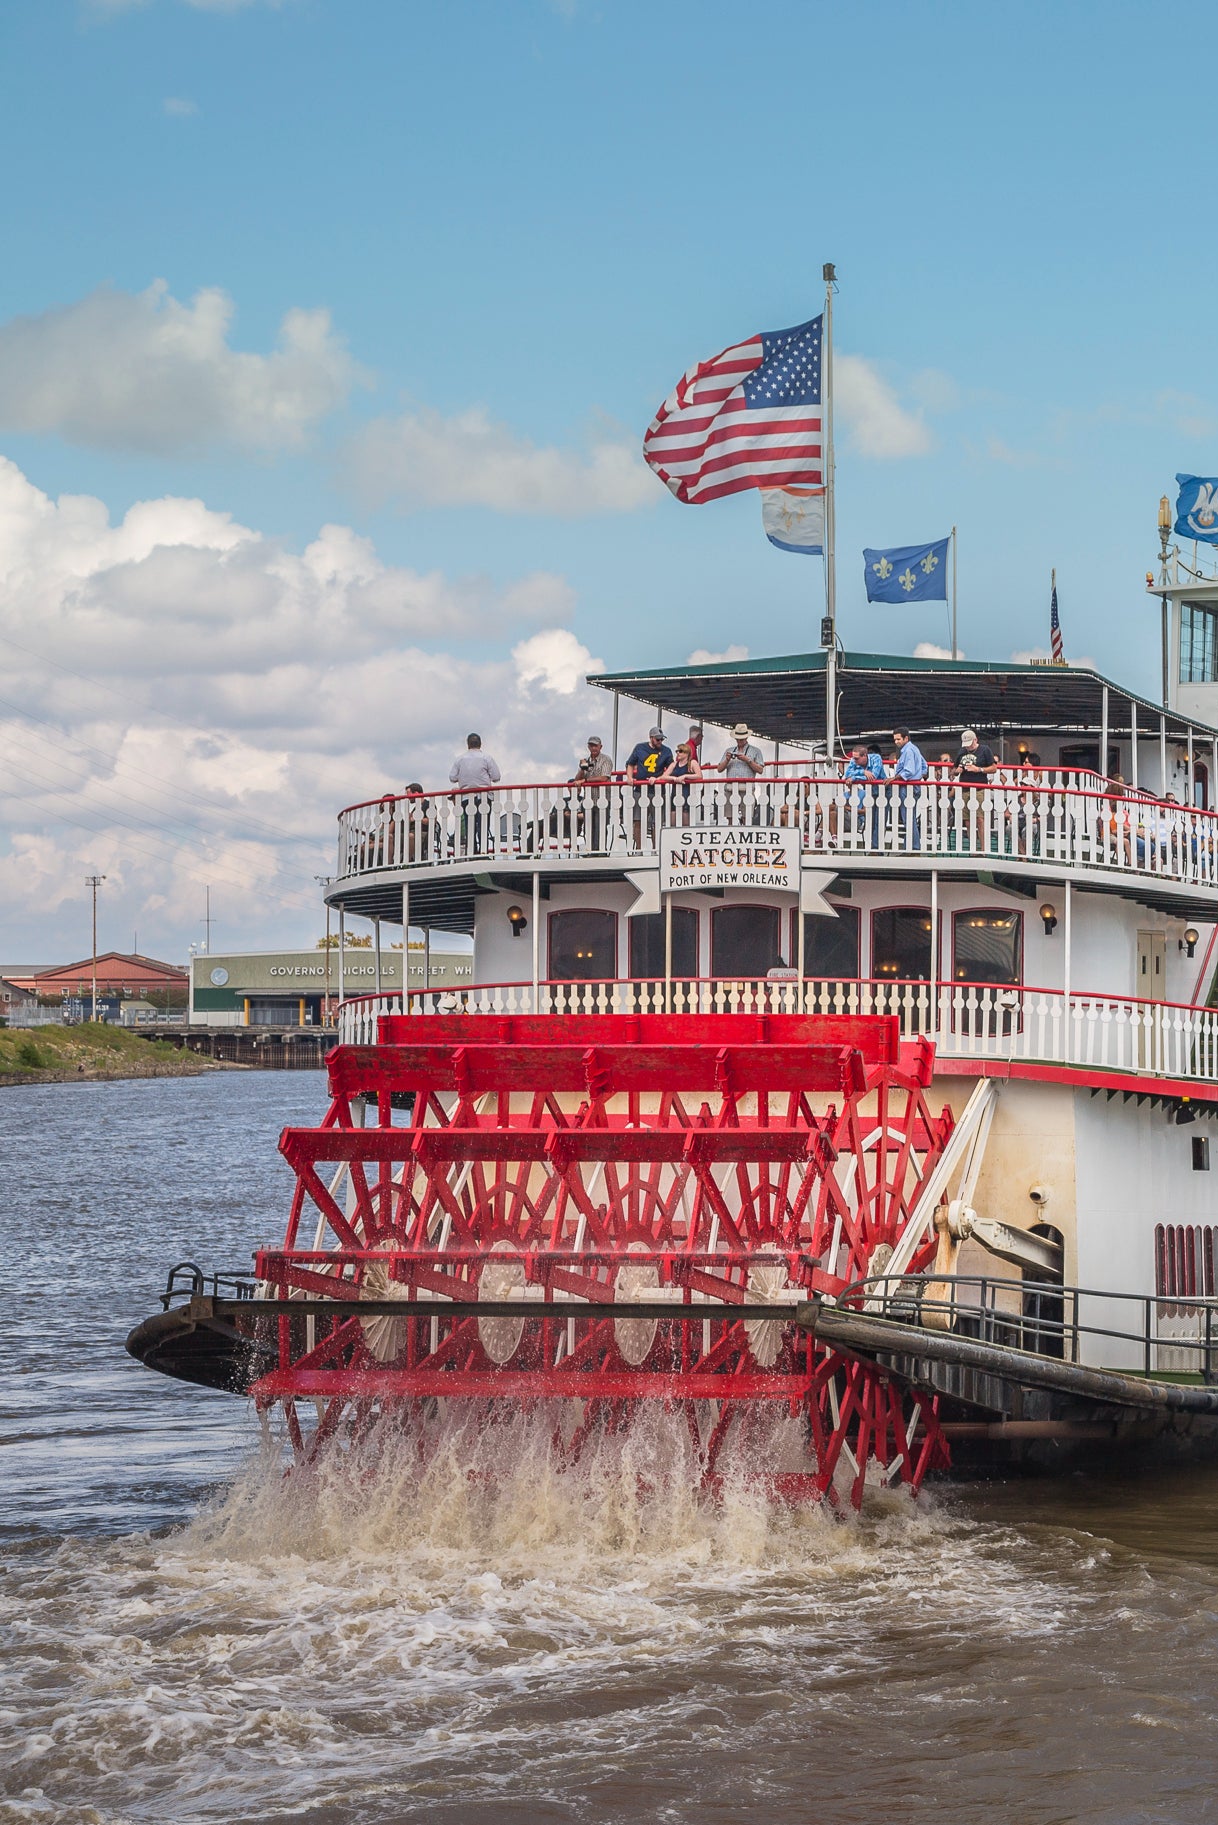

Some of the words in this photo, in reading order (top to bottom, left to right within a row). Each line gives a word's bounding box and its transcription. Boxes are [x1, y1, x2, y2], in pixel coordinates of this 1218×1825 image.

[643, 753, 659, 773] 4
[680, 831, 781, 845] STEAMER
[670, 848, 787, 868] NATCHEZ
[669, 874, 695, 887] PORT
[700, 873, 712, 884] OF
[716, 873, 738, 883] NEW
[742, 873, 789, 887] ORLEANS
[341, 966, 395, 976] NICHOLS
